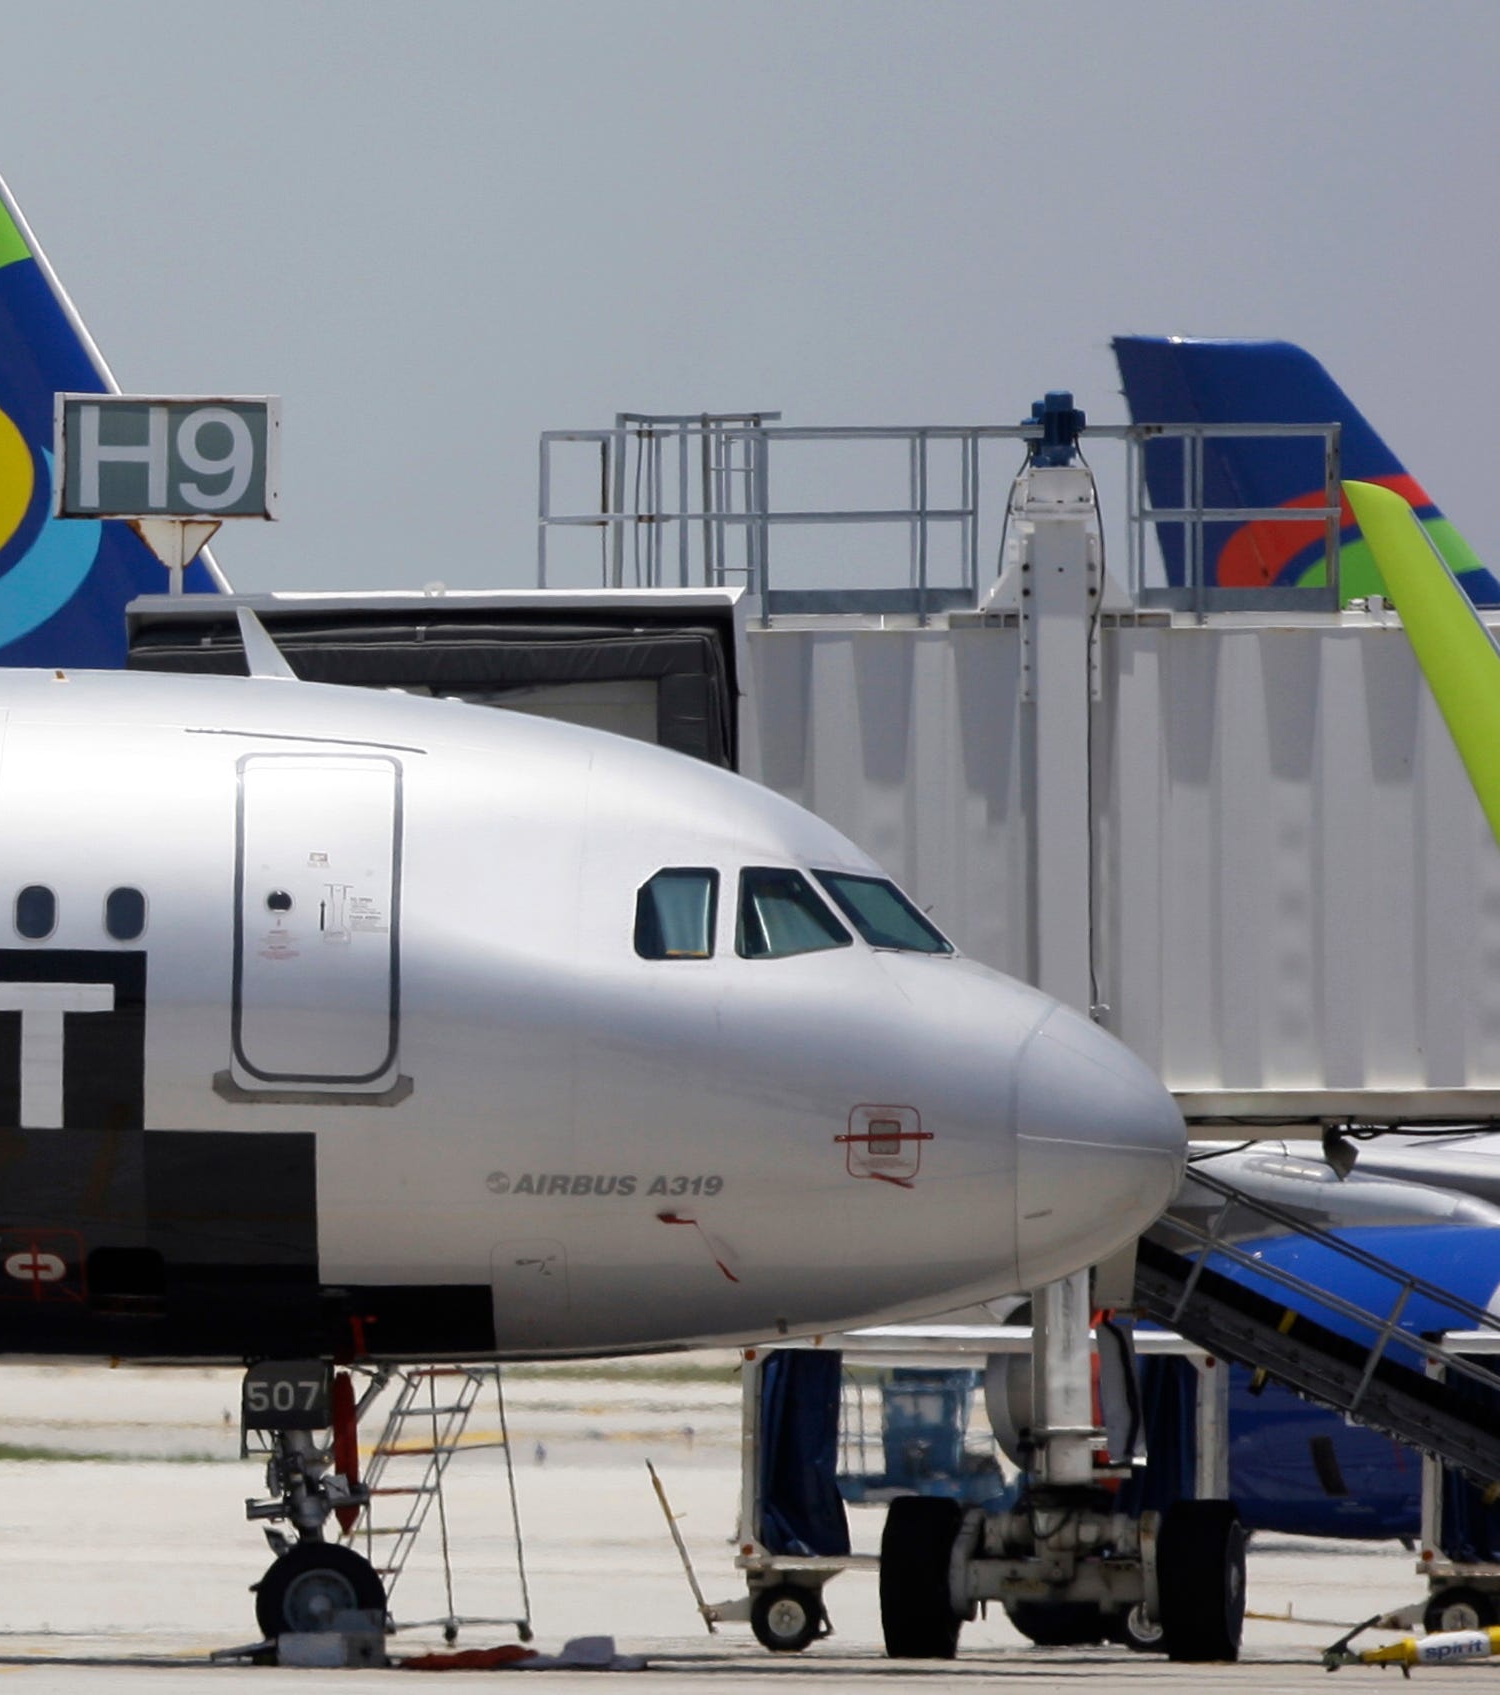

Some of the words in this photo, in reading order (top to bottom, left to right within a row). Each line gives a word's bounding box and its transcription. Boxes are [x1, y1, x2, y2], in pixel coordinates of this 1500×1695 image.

[79, 405, 254, 510] H9
[512, 1173, 638, 1197] AIRBUS
[646, 1175, 724, 1197] A319
[247, 1381, 320, 1411] 507
